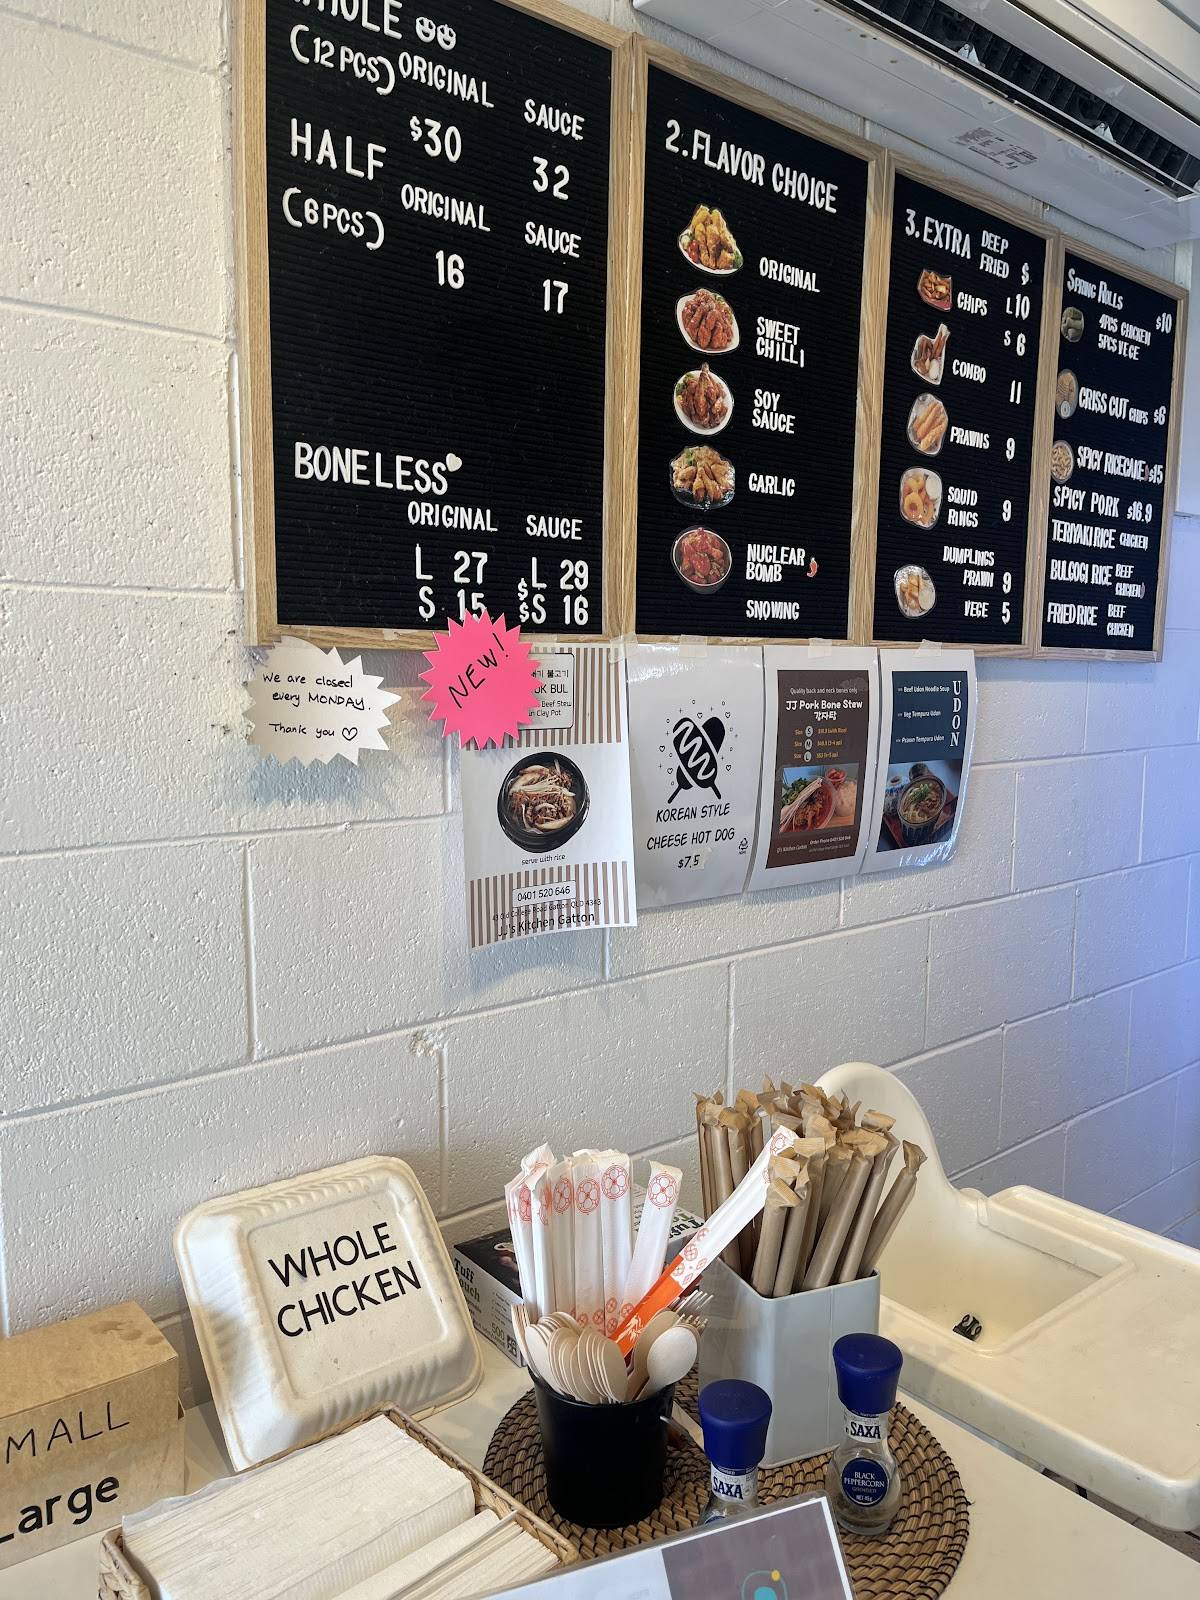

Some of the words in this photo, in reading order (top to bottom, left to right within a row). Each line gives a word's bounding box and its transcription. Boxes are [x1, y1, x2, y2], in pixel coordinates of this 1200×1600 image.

[294, 0, 403, 40] OLE
[398, 51, 495, 108] ORIGINAL
[523, 98, 585, 141] SAUCE
[290, 117, 387, 181] HALF
[409, 116, 462, 163] $30
[532, 155, 570, 200] 32
[771, 162, 839, 214] CHOICE
[400, 183, 491, 232] ORIGINAL
[524, 221, 582, 258] SAUCE
[981, 229, 1009, 255] DEEP
[434, 249, 465, 289] 16
[541, 278, 569, 314] 17
[758, 256, 821, 293] ORIGINAL
[979, 252, 1010, 279] FRIED
[1021, 262, 1031, 286] $
[1066, 267, 1097, 300] SPRING
[957, 290, 988, 317] CHIPS
[756, 315, 801, 346] SWEET
[1099, 313, 1118, 333] 4PCS
[1120, 321, 1151, 347] CHICKEN
[1155, 312, 1173, 335] $10
[755, 336, 805, 369] CHILLI
[1017, 332, 1027, 357] 6
[1098, 333, 1117, 353] 5PCS
[952, 359, 987, 384] COMBO
[753, 388, 781, 412] SOY
[1009, 379, 1023, 405] 11
[1078, 386, 1108, 415] CRISS
[1108, 395, 1130, 420] CUT
[1128, 407, 1149, 426] CHIPS
[1153, 405, 1167, 426] $6
[751, 408, 796, 435] SAUCE
[949, 425, 990, 450] PRAWNS
[1005, 437, 1016, 462] 9
[1076, 444, 1104, 472] SPICY
[1149, 463, 1164, 486] $15
[748, 472, 796, 497] GARLIC
[947, 486, 978, 507] SQUID
[947, 508, 979, 528] RINGS
[1002, 499, 1012, 522] 9
[1053, 484, 1087, 512] SPICY
[1090, 491, 1120, 519] PORK
[1126, 500, 1153, 525] $16.9
[407, 500, 498, 532] ORIGINAL
[525, 514, 584, 541] SAUCE
[1051, 518, 1095, 549] TERIYAKI
[1094, 527, 1118, 550] RICE
[1119, 531, 1149, 552] CHICKEN
[415, 543, 434, 581] L
[453, 550, 489, 585] 27
[559, 559, 589, 592] 29
[747, 542, 807, 567] NUCLEAR
[942, 545, 995, 567] DUMPLINGS
[746, 561, 783, 583] BOMB
[963, 568, 994, 589] PRAWN
[1002, 571, 1012, 595] 9
[1050, 558, 1089, 586] BULGOGI
[1091, 563, 1114, 587] RICE
[1115, 563, 1135, 580] BEEF
[1115, 582, 1142, 598] CHICKEN
[418, 586, 436, 622] S
[456, 588, 486, 623] 15
[562, 595, 589, 626] 16
[746, 599, 801, 621] SNOWING
[964, 600, 989, 619] VEGE
[1001, 601, 1011, 625] 5
[1046, 601, 1077, 625] FRIED
[1076, 605, 1099, 627] RICE
[1107, 603, 1128, 620] BEEF
[1106, 622, 1135, 639] CHICKEN
[262, 672, 282, 683] We
[287, 674, 307, 684] are
[315, 674, 354, 688] closed
[550, 683, 569, 694] BUL
[272, 691, 301, 708] every
[536, 709, 550, 717] Clay
[550, 708, 562, 716] Pot
[541, 700, 556, 708] Beef
[785, 700, 798, 711] JJ
[799, 700, 820, 710] Pork
[821, 699, 842, 710] Bone
[842, 699, 864, 709] Stew
[950, 680, 962, 747] UDON
[268, 722, 308, 735] Thank
[315, 727, 336, 739] you
[655, 805, 698, 823] KOREAN
[700, 802, 731, 819] STYLE
[646, 832, 689, 851] CHEESE
[691, 830, 713, 844] HOT
[714, 827, 736, 842] DOG
[521, 857, 539, 866] serve
[539, 854, 554, 864] with
[553, 853, 566, 862] rice
[517, 890, 537, 902] 0401
[538, 887, 554, 898] 520
[554, 885, 571, 896] 646
[518, 916, 555, 933] Kitchen
[557, 912, 596, 925] Gatton
[267, 1221, 397, 1288] WHOLE
[276, 1259, 422, 1338] CHICKEN
[459, 1276, 481, 1303] ouch
[849, 1421, 882, 1440] SAXA
[712, 1475, 744, 1500] SAXA
[843, 1476, 886, 1488] PEPPERCORN
[853, 1470, 876, 1480] BLACK
[0, 1476, 120, 1544] arge
